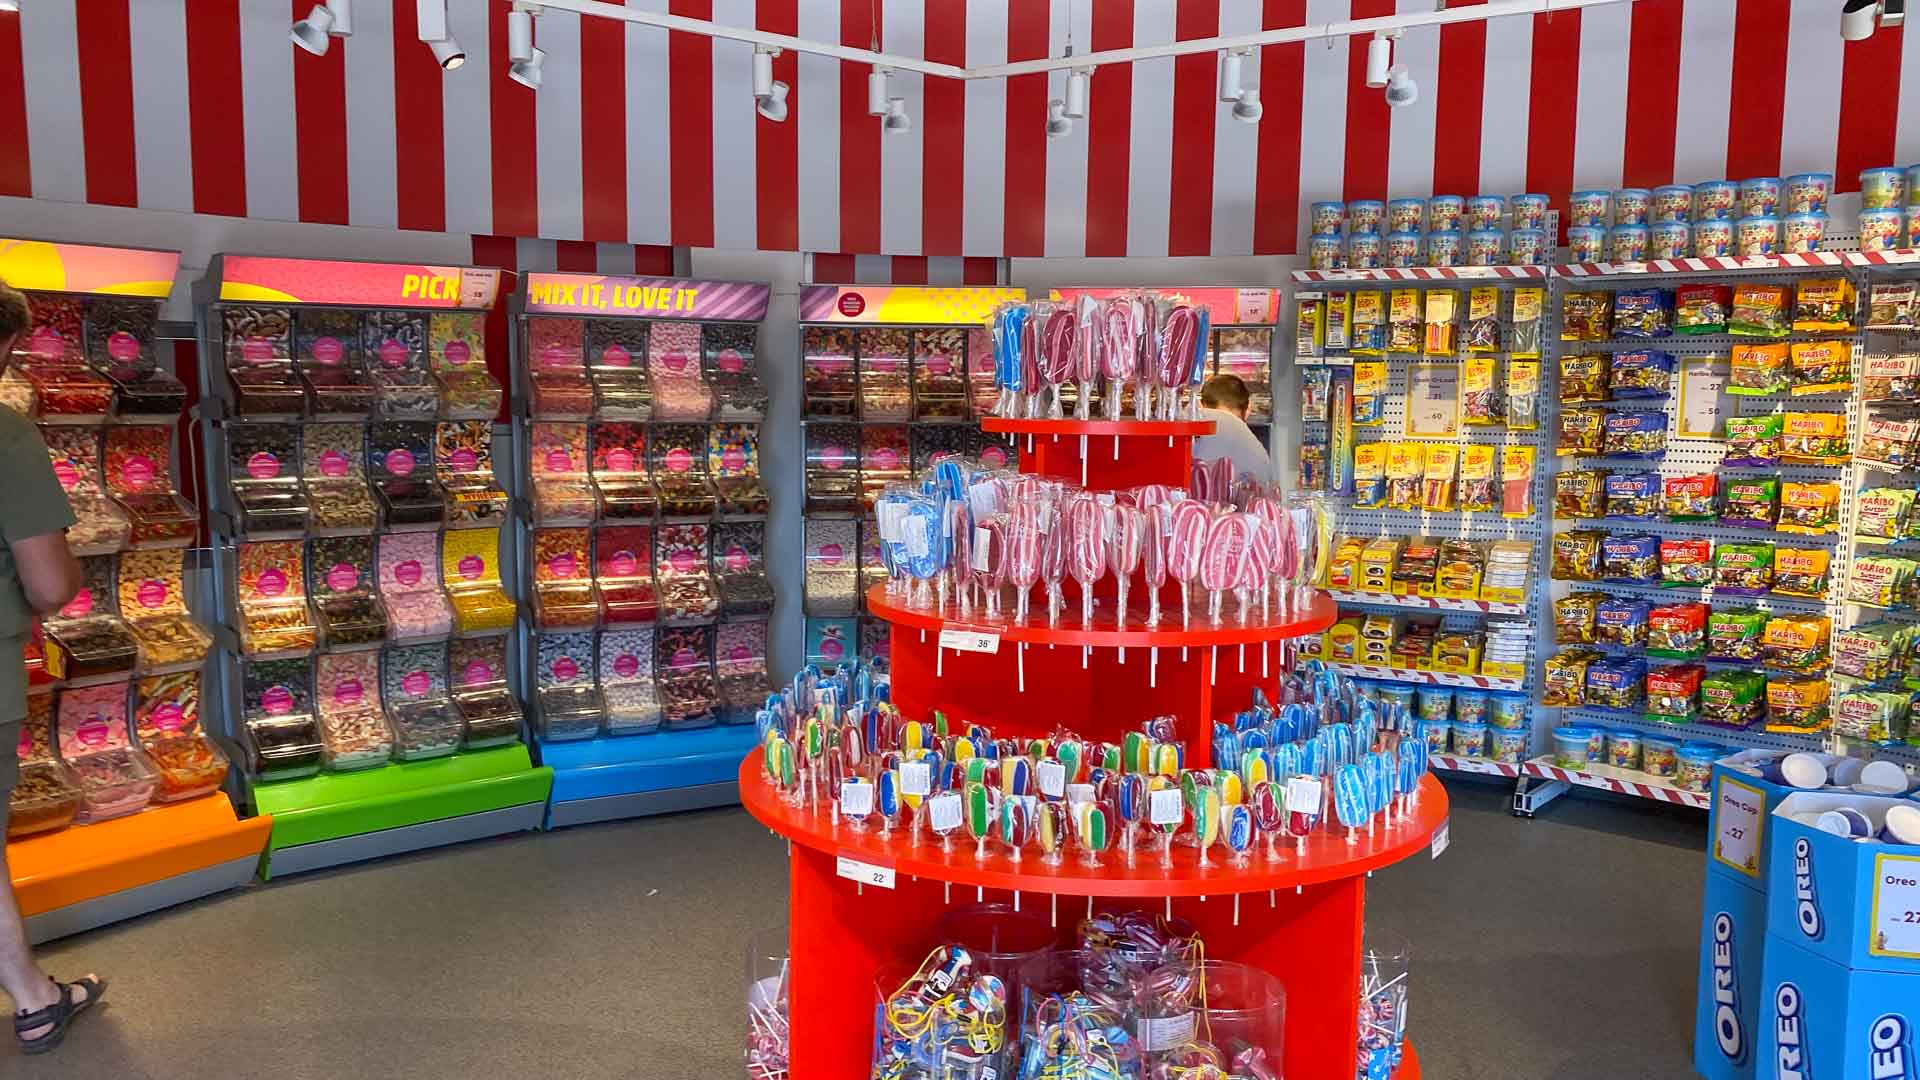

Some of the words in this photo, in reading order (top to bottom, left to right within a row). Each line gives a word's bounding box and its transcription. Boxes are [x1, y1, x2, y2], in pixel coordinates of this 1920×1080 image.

[401, 273, 460, 301] PICK
[531, 281, 575, 306] MIX
[582, 283, 607, 309] IT,
[613, 285, 672, 311] LOVE
[675, 288, 699, 312] IT
[1798, 349, 1831, 358] HARIBO
[1871, 361, 1904, 369] HARIBO
[1731, 425, 1765, 433] HARIBO
[1860, 497, 1895, 506] HARIBO
[1721, 553, 1755, 562] HARIBO
[1856, 563, 1892, 575] HARIBO
[1560, 608, 1589, 616] HARIBO
[1713, 622, 1745, 632] HARIBO
[1770, 630, 1804, 640] HARIBO
[1840, 635, 1876, 649] HARIBO
[1841, 699, 1878, 712] HARIBO
[1723, 795, 1740, 808] Oreo
[1741, 802, 1759, 816] Cup
[1731, 827, 1744, 840] 27
[873, 872, 884, 883] 22
[1885, 875, 1917, 887] Oreo
[1795, 838, 1820, 936] OREO
[1904, 911, 1920, 924] 27
[1714, 912, 1742, 1057] OREO
[1775, 983, 1803, 1080] REO
[1871, 1013, 1905, 1080] EO
